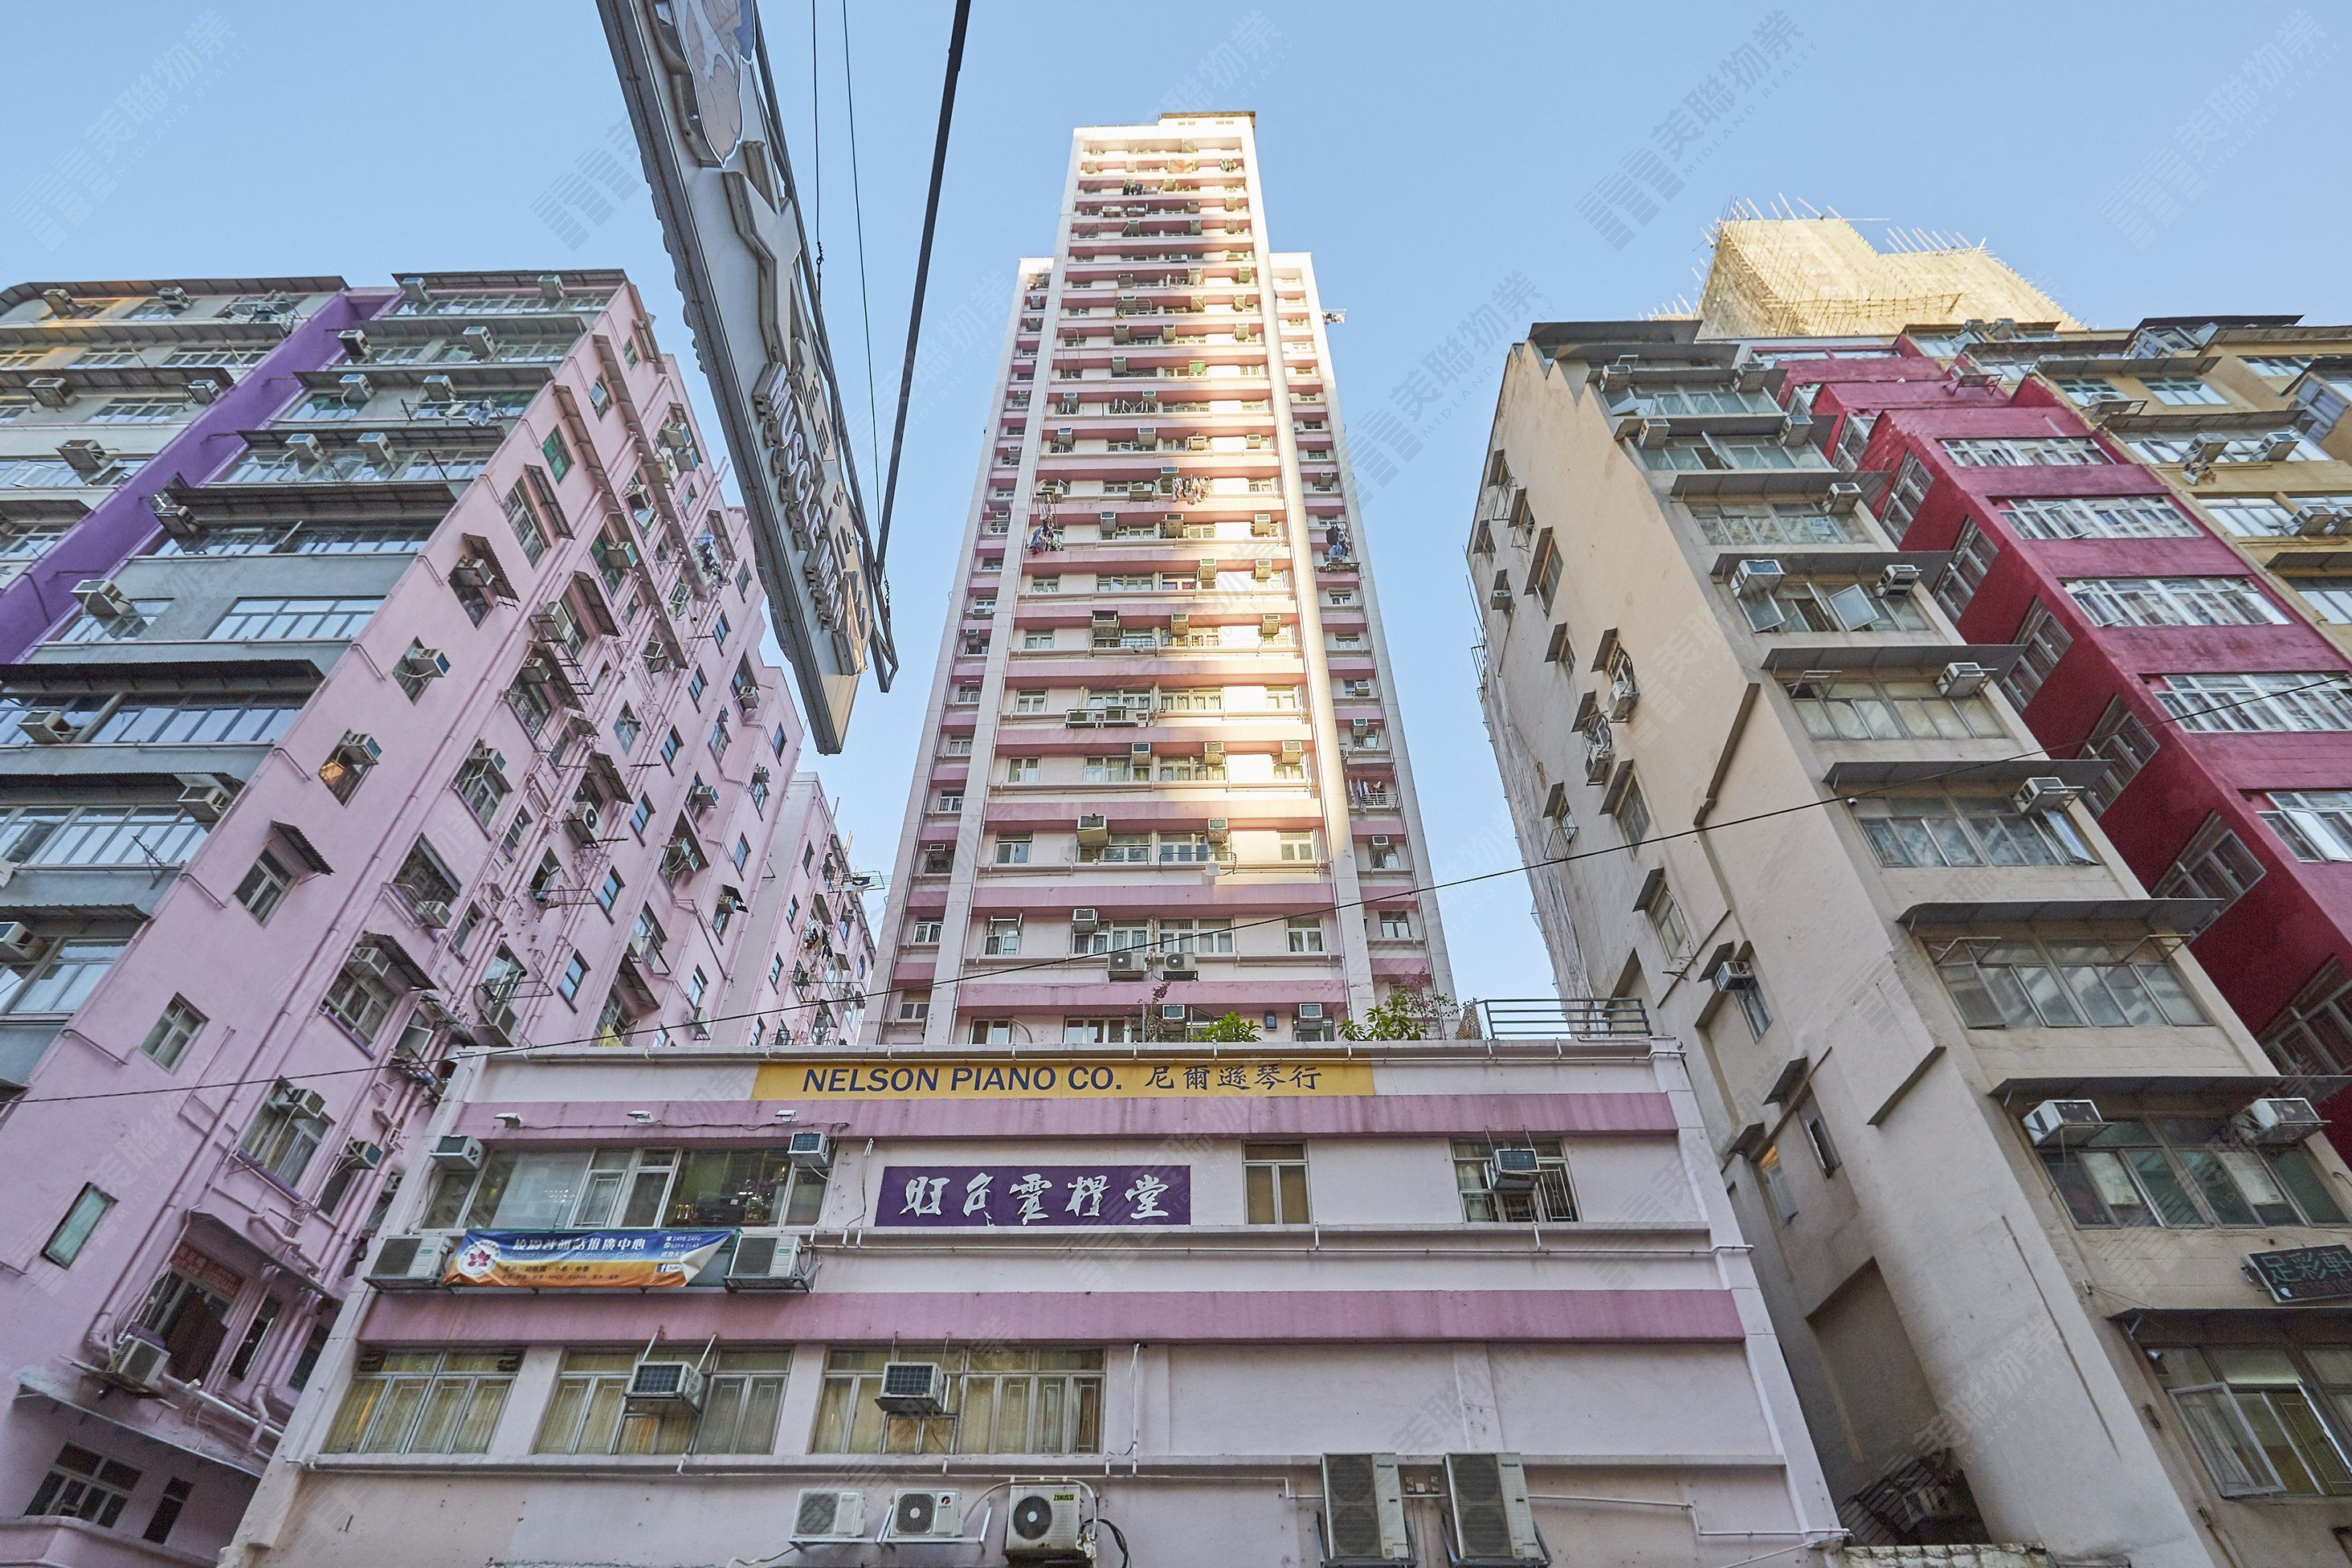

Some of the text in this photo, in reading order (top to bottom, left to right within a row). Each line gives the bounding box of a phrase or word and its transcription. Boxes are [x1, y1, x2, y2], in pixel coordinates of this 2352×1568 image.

[760, 362, 845, 631] MUSCLE MAN
[802, 1066, 1123, 1092] NELSON PIANO CO.
[1145, 1063, 1322, 1091] 尼爾遜琴行
